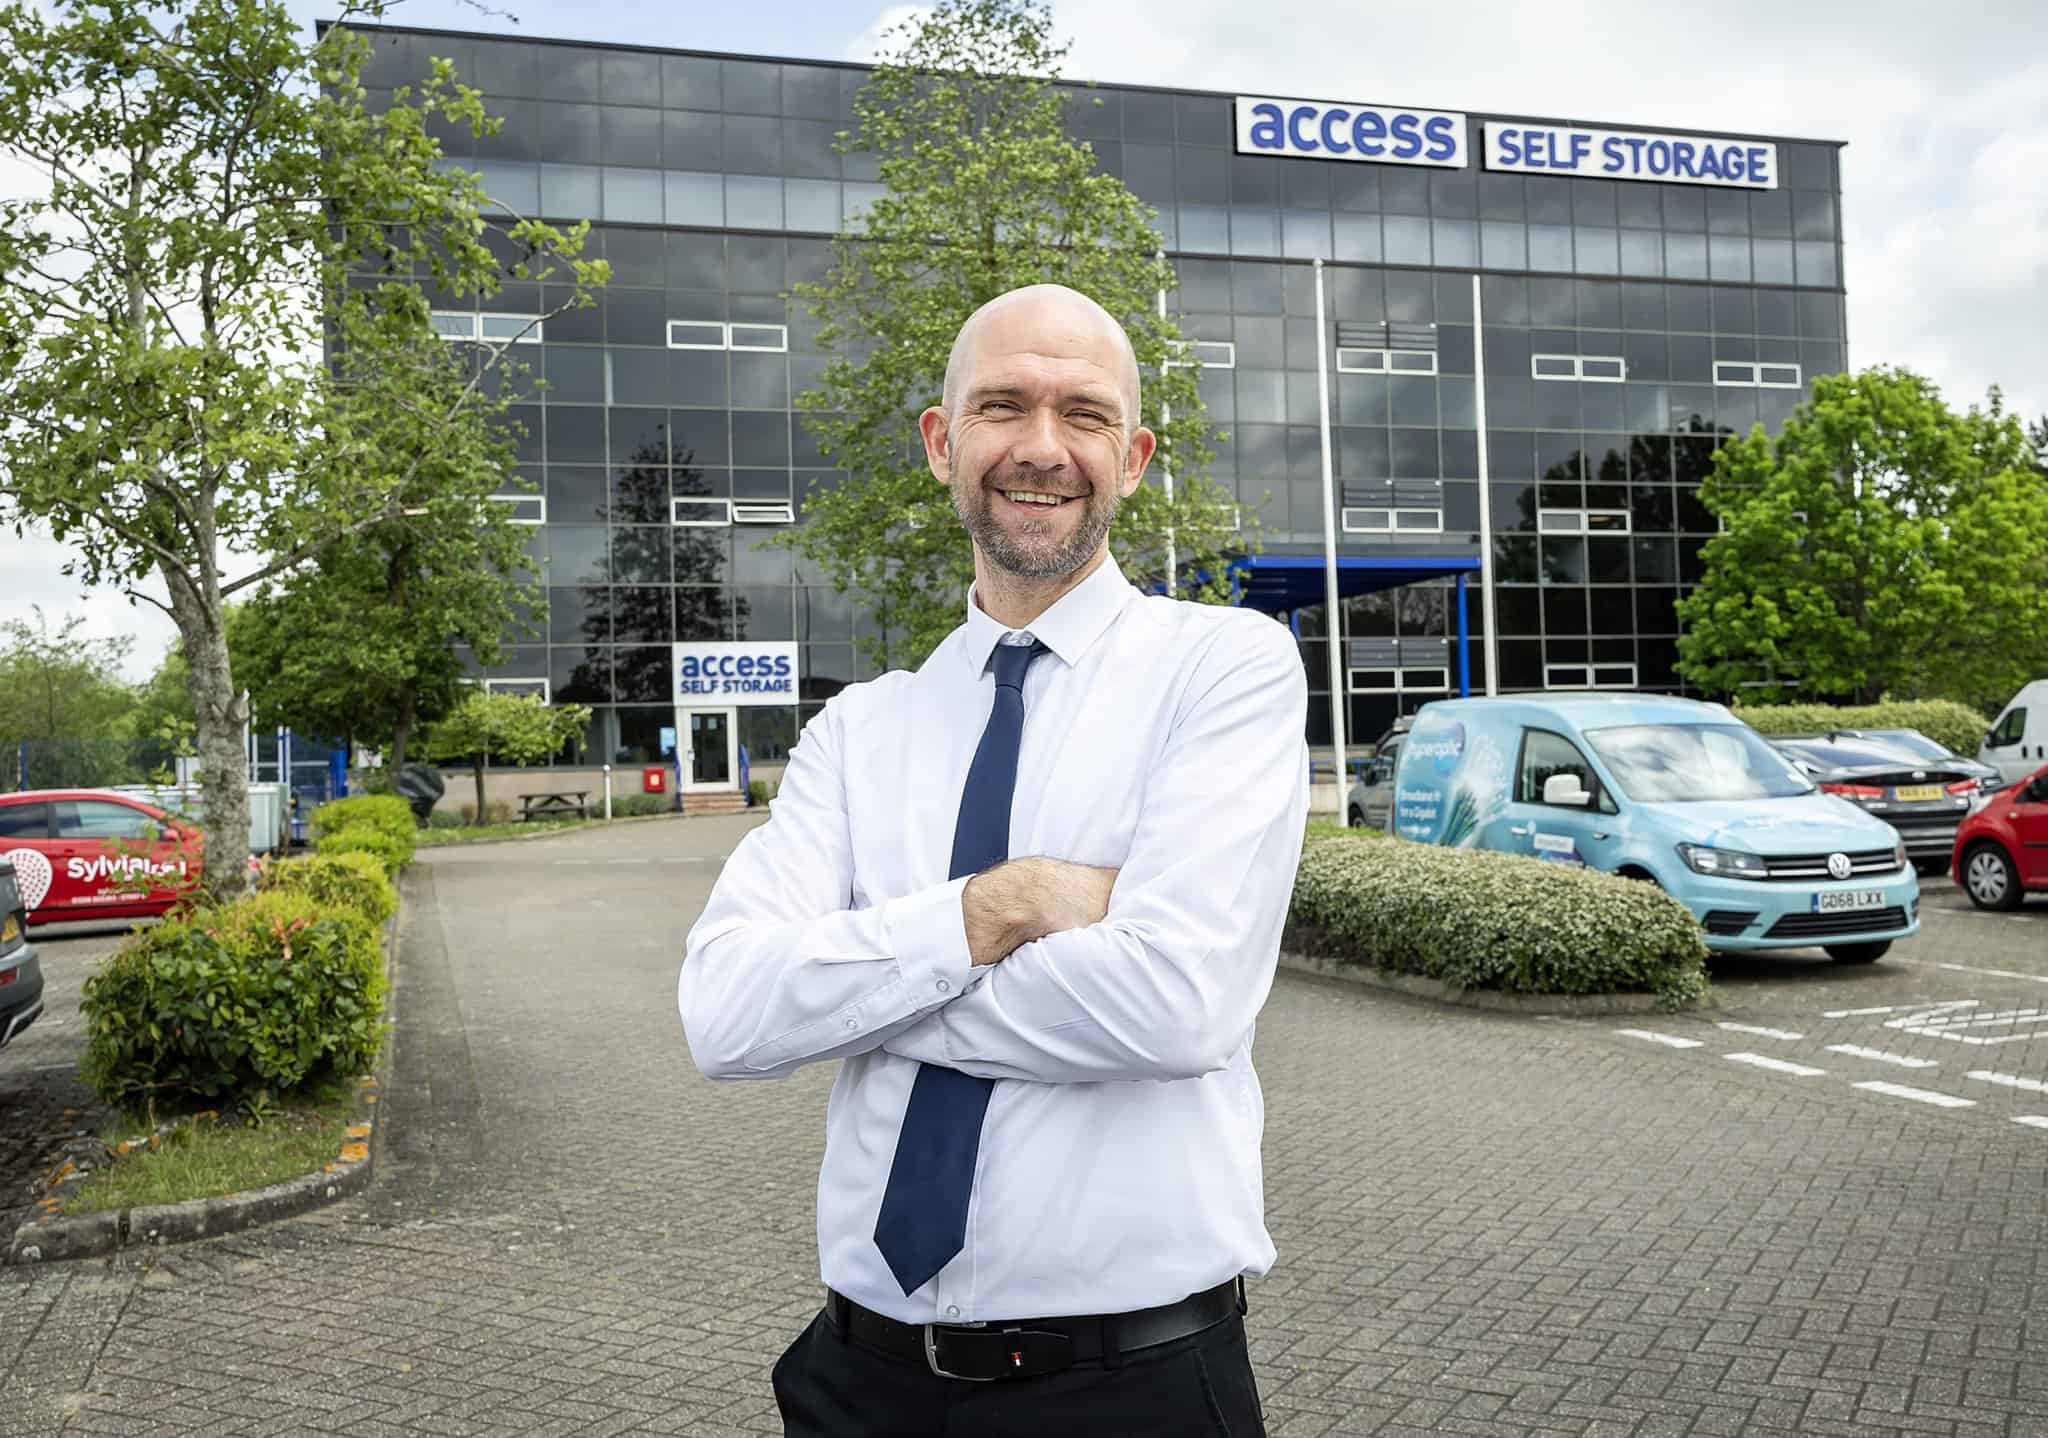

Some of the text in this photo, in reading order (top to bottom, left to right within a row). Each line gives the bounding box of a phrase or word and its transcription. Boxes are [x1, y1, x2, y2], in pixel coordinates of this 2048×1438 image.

[1250, 103, 1457, 161] access
[1499, 129, 1769, 182] SELF STORAGE
[681, 655, 791, 677] access
[680, 679, 792, 694] SELF STORAGE
